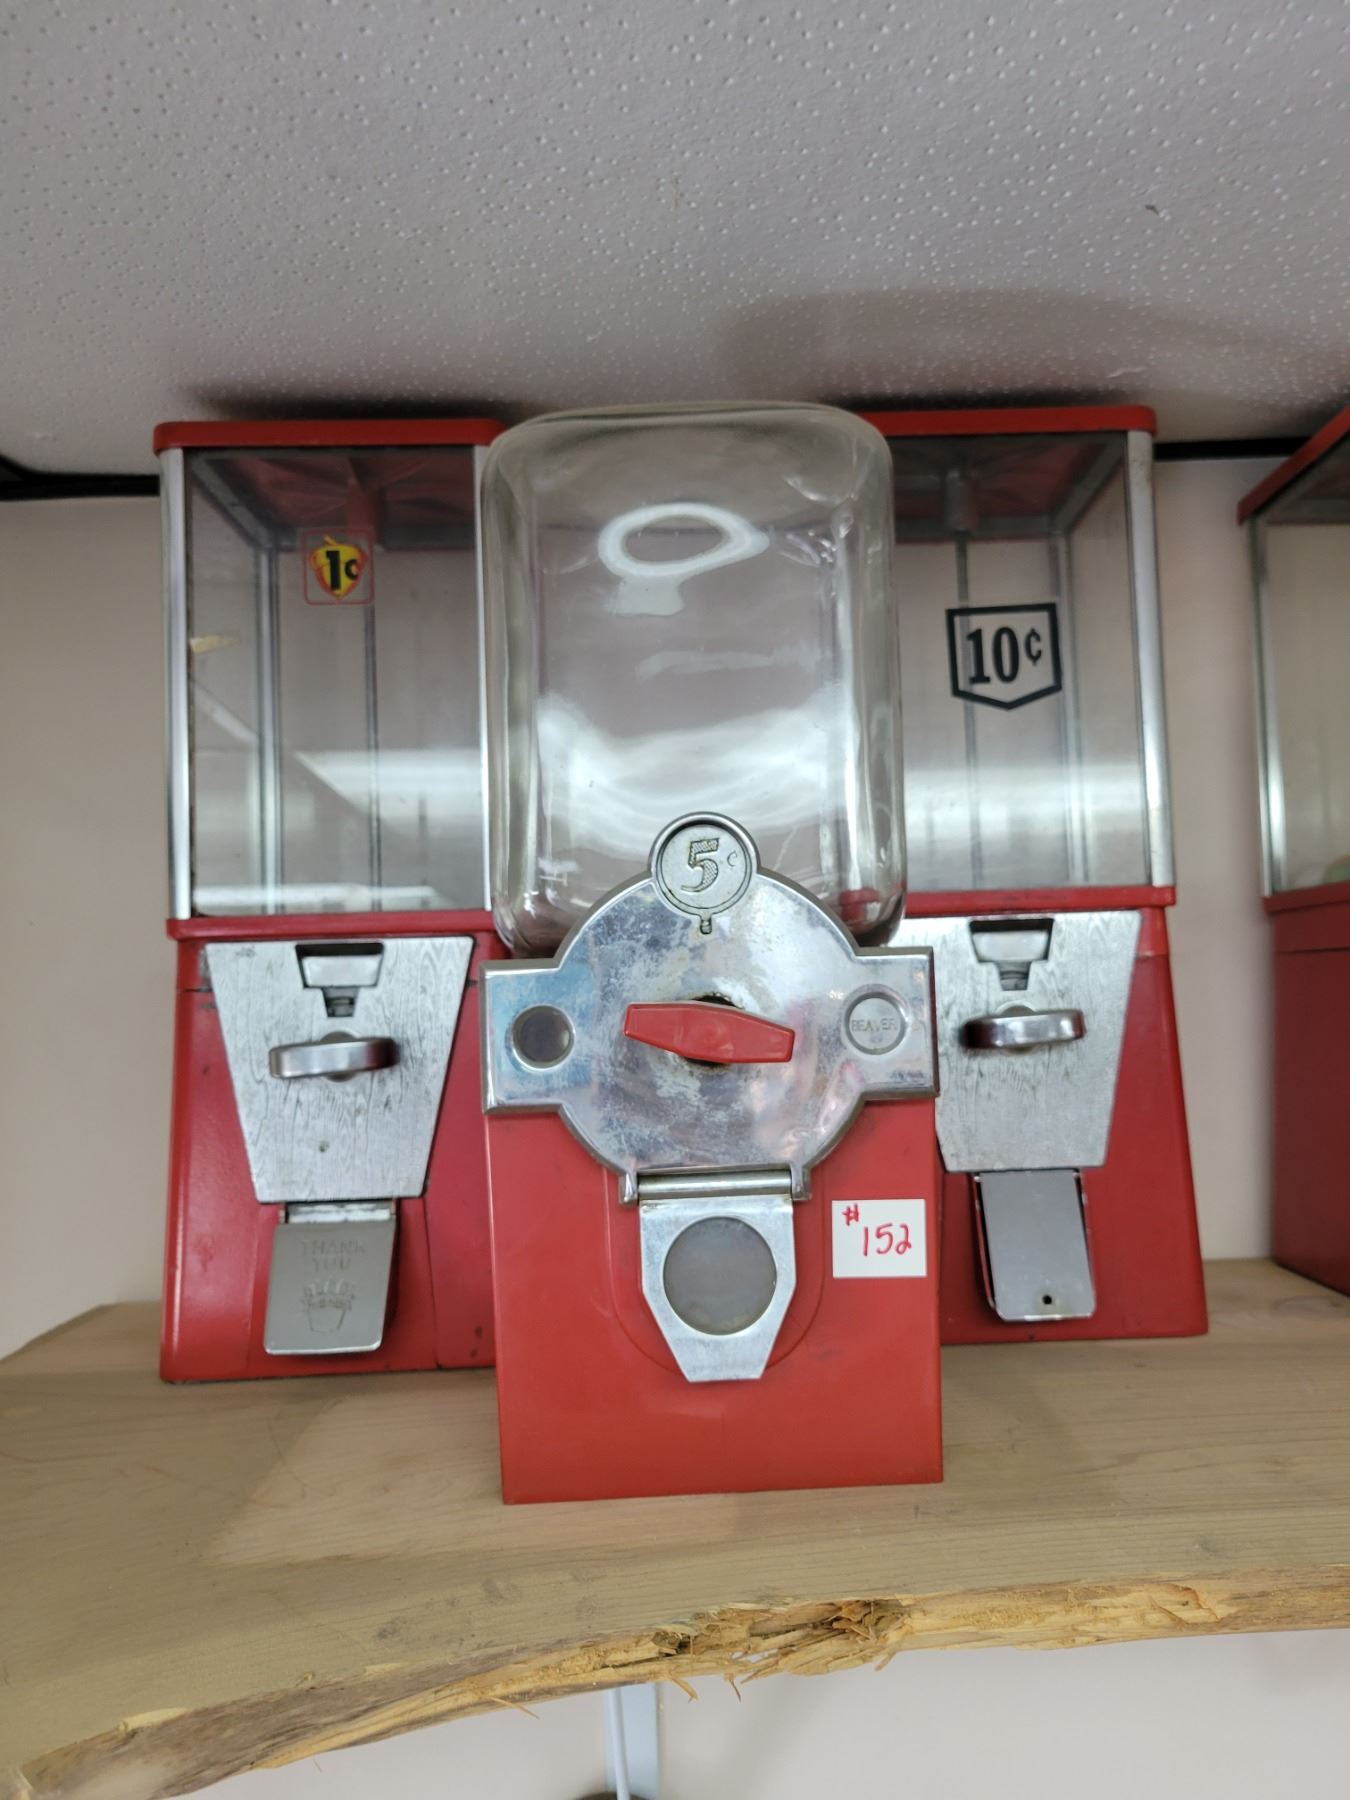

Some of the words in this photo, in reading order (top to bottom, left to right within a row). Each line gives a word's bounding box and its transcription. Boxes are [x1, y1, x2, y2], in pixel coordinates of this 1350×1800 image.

[966, 626, 1042, 684] 10¢
[300, 1239, 366, 1256] THANK
[311, 1256, 352, 1273] YOU
